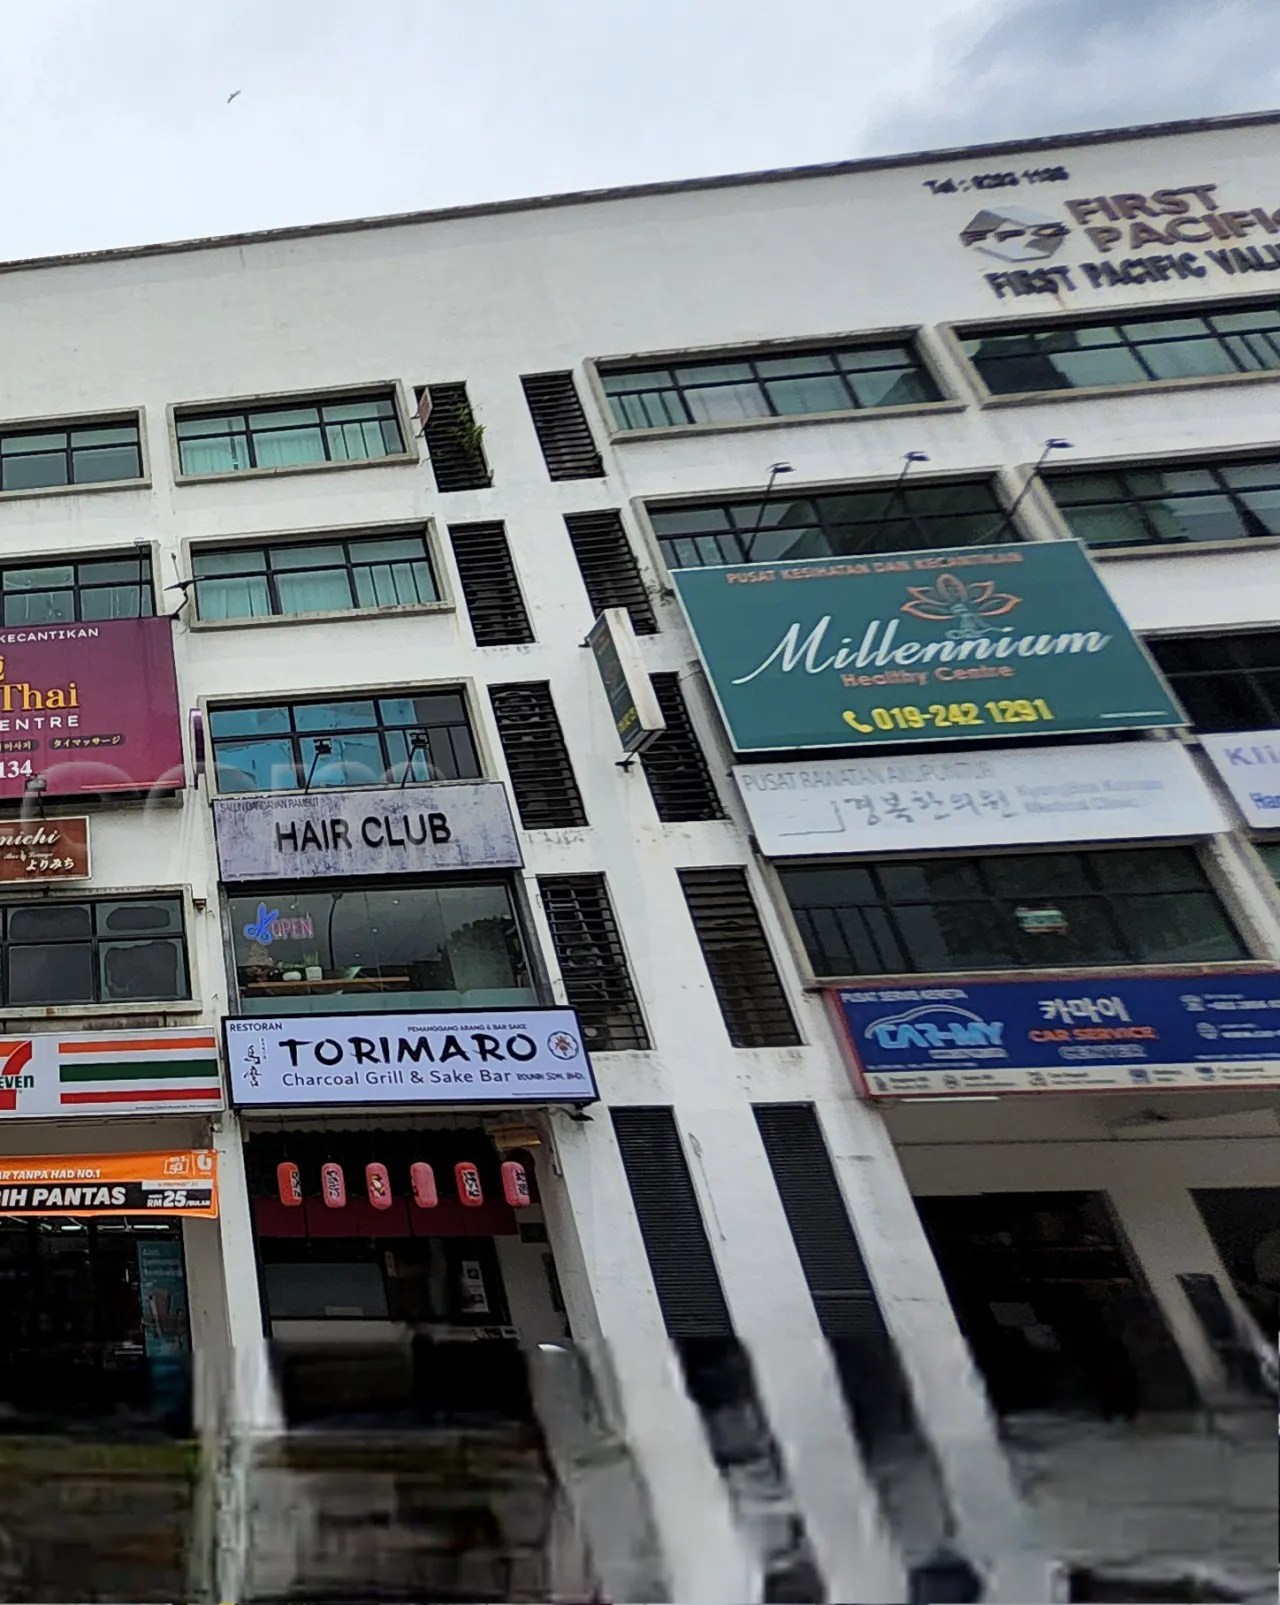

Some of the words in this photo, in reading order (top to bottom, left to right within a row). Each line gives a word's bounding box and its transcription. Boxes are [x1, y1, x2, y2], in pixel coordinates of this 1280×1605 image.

[1063, 183, 1218, 225] FIRST
[983, 265, 1076, 299] FIRST
[1078, 251, 1208, 289] PACIFIC
[730, 614, 1113, 686] Millennium
[934, 664, 1016, 681] Centre
[871, 702, 985, 731] 019-242
[275, 817, 352, 852] HAIR
[361, 811, 452, 849] CLUB
[26, 857, 75, 872] よりみち
[271, 918, 314, 940] OPEN
[229, 1022, 283, 1032] RESTORAN
[1028, 1028, 1070, 1042] CAR
[1072, 1026, 1160, 1041] SERVICE
[278, 1033, 537, 1067] TORIMARO
[282, 1072, 360, 1087] Charcoal
[366, 1071, 404, 1085] Grill
[410, 1070, 424, 1083] &
[430, 1068, 474, 1083] Sake
[480, 1070, 512, 1083] Bar
[11, 1170, 48, 1180] TANPA
[50, 1169, 74, 1179] HAD
[76, 1169, 101, 1178] NO.1
[31, 1186, 126, 1206] PANTAS
